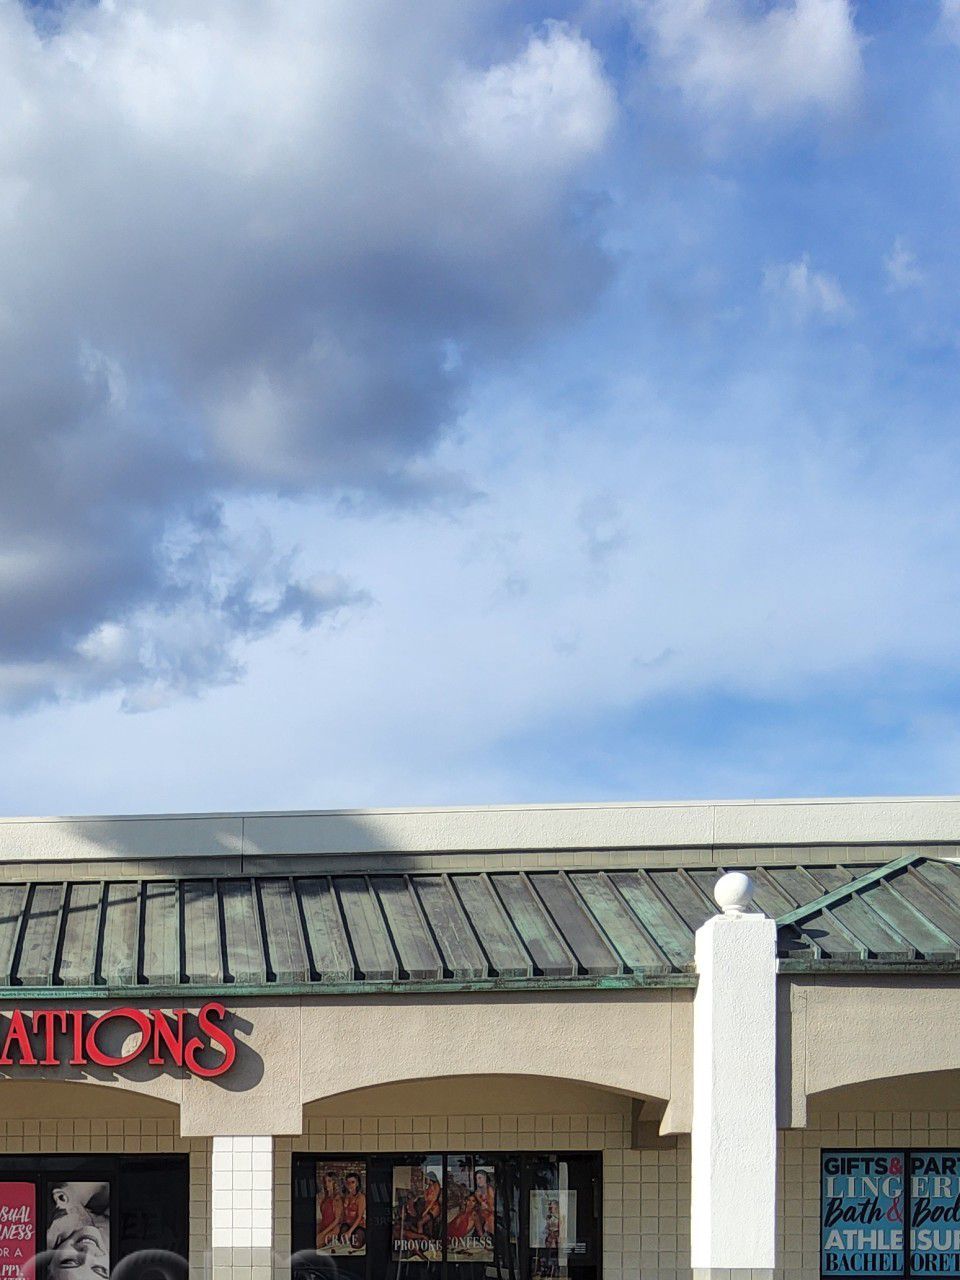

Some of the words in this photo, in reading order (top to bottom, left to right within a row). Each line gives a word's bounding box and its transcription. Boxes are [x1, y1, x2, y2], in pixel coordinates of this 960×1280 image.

[825, 1176, 960, 1198] LINGER
[448, 1236, 494, 1249] ONFESS
[14, 1248, 23, 1257] A
